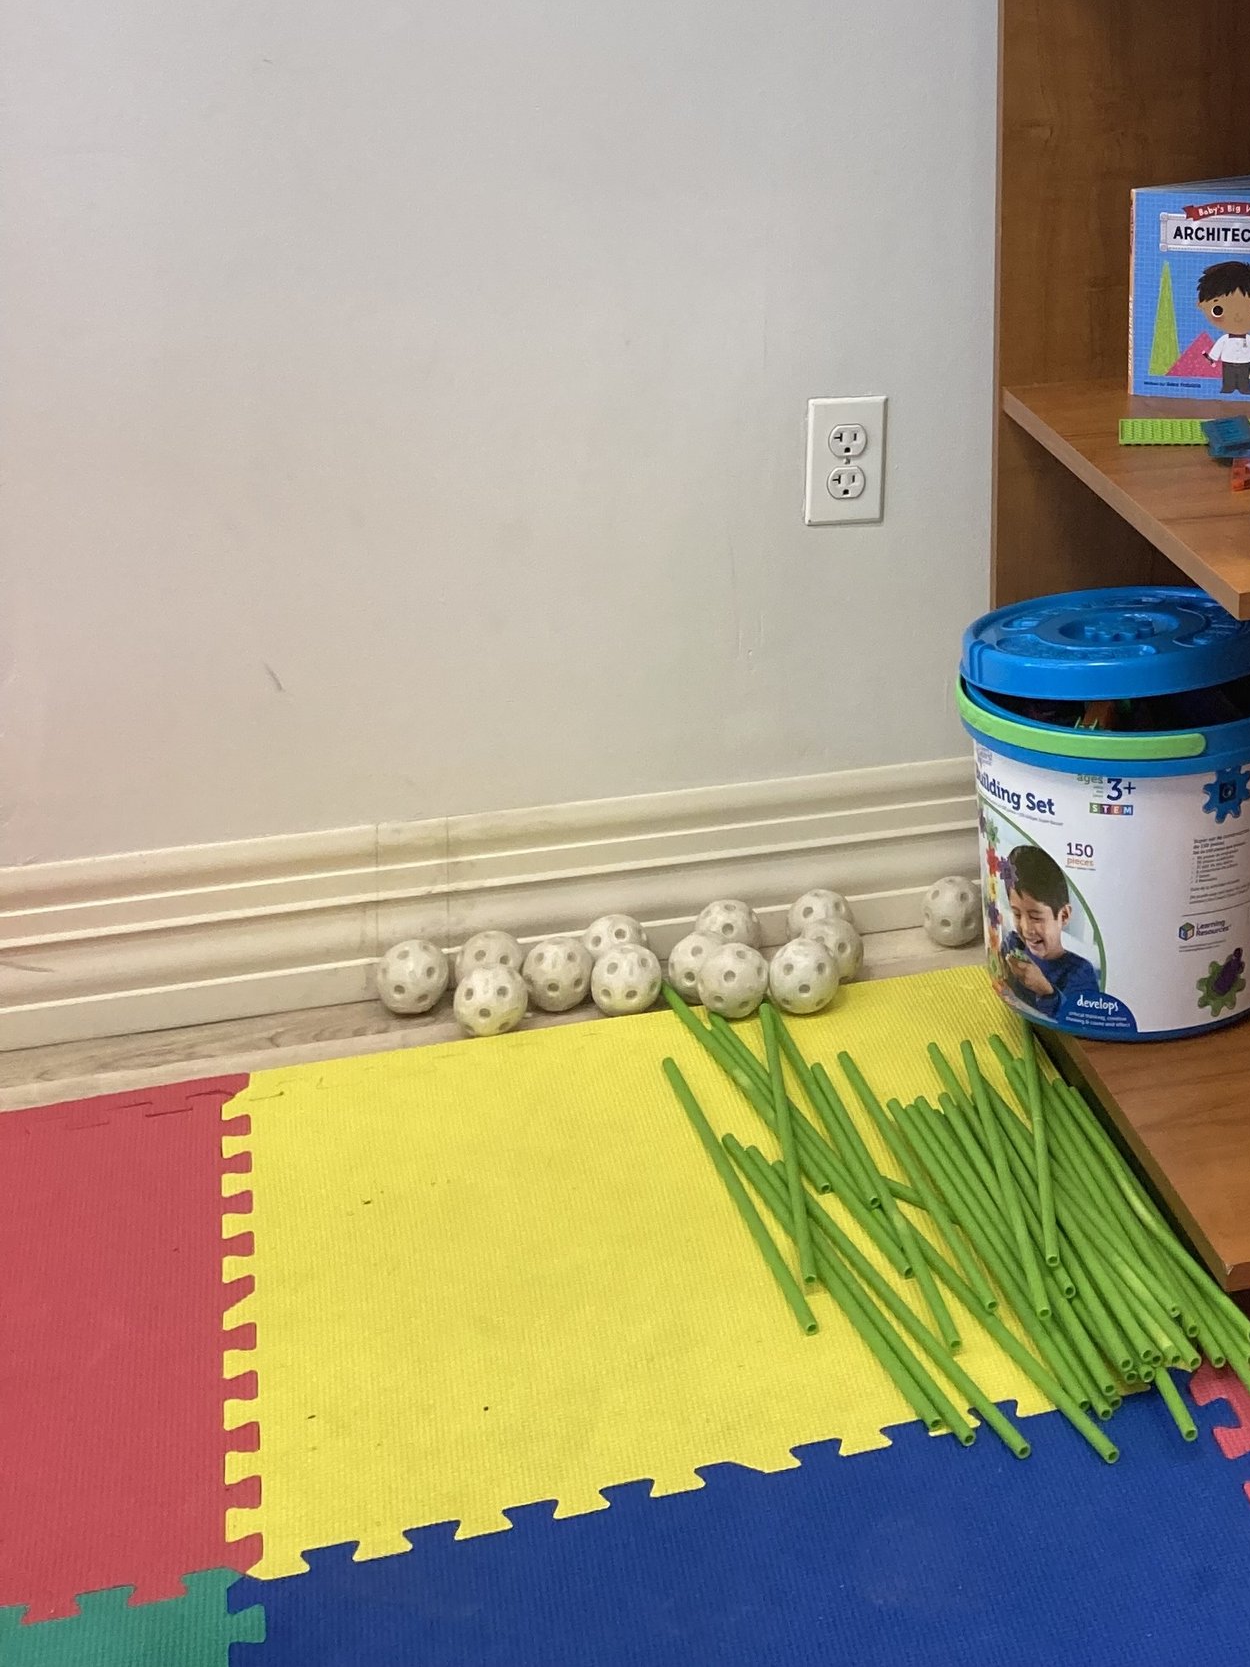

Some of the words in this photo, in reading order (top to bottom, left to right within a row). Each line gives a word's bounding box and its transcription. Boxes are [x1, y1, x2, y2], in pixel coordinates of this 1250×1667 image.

[1198, 204, 1224, 216] Baby's
[1227, 205, 1240, 213] Big
[1076, 774, 1103, 784] ages
[1107, 777, 1136, 801] 3+
[1026, 792, 1055, 815] Set
[1090, 804, 1133, 815] STEM
[1066, 842, 1094, 858] 150
[1067, 858, 1094, 866] pieces
[1197, 920, 1225, 930] Learning
[1077, 994, 1119, 1015] develops
